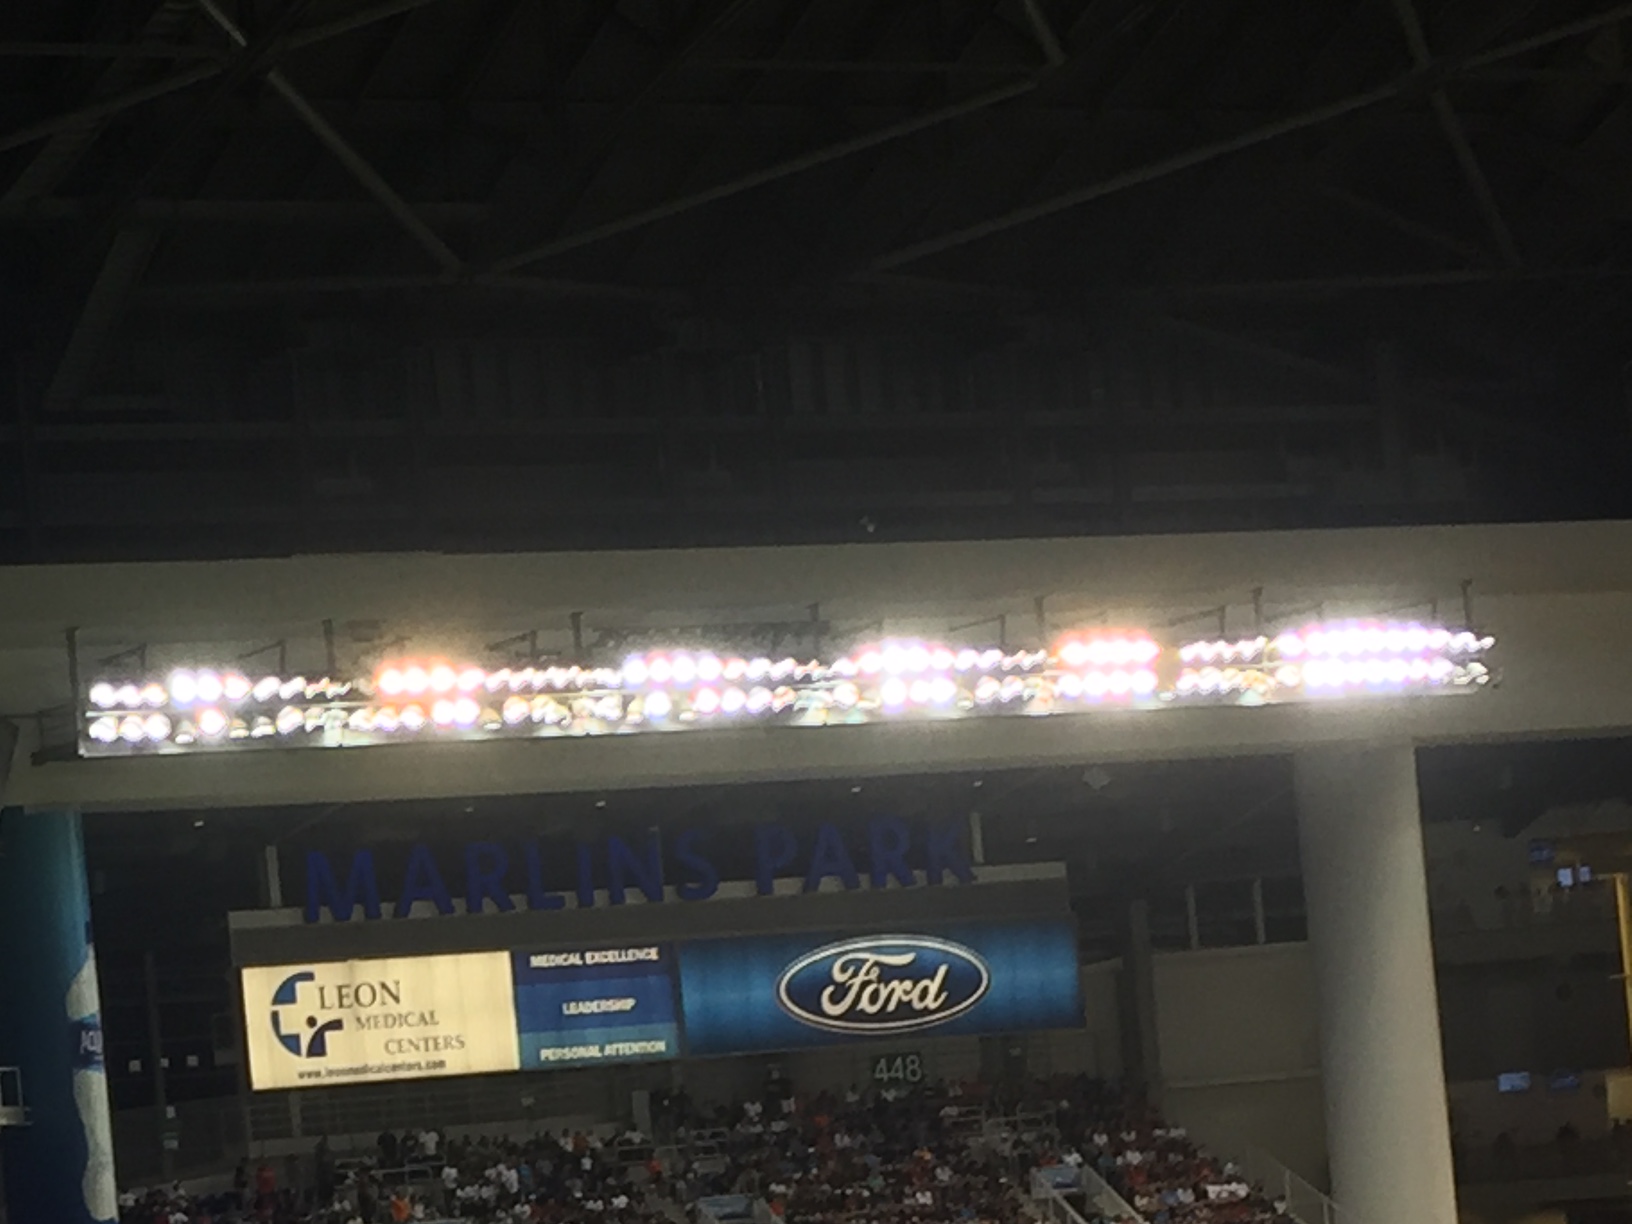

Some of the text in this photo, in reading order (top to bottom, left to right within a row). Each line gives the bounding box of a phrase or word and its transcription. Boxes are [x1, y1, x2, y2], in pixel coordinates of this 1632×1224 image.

[302, 819, 977, 925] MARLINS PARK
[317, 979, 401, 1010] LEON
[821, 951, 949, 1018] Ford
[355, 1010, 440, 1031] MEDICAL
[384, 1034, 466, 1056] CENTERS
[873, 1054, 922, 1082] 448
